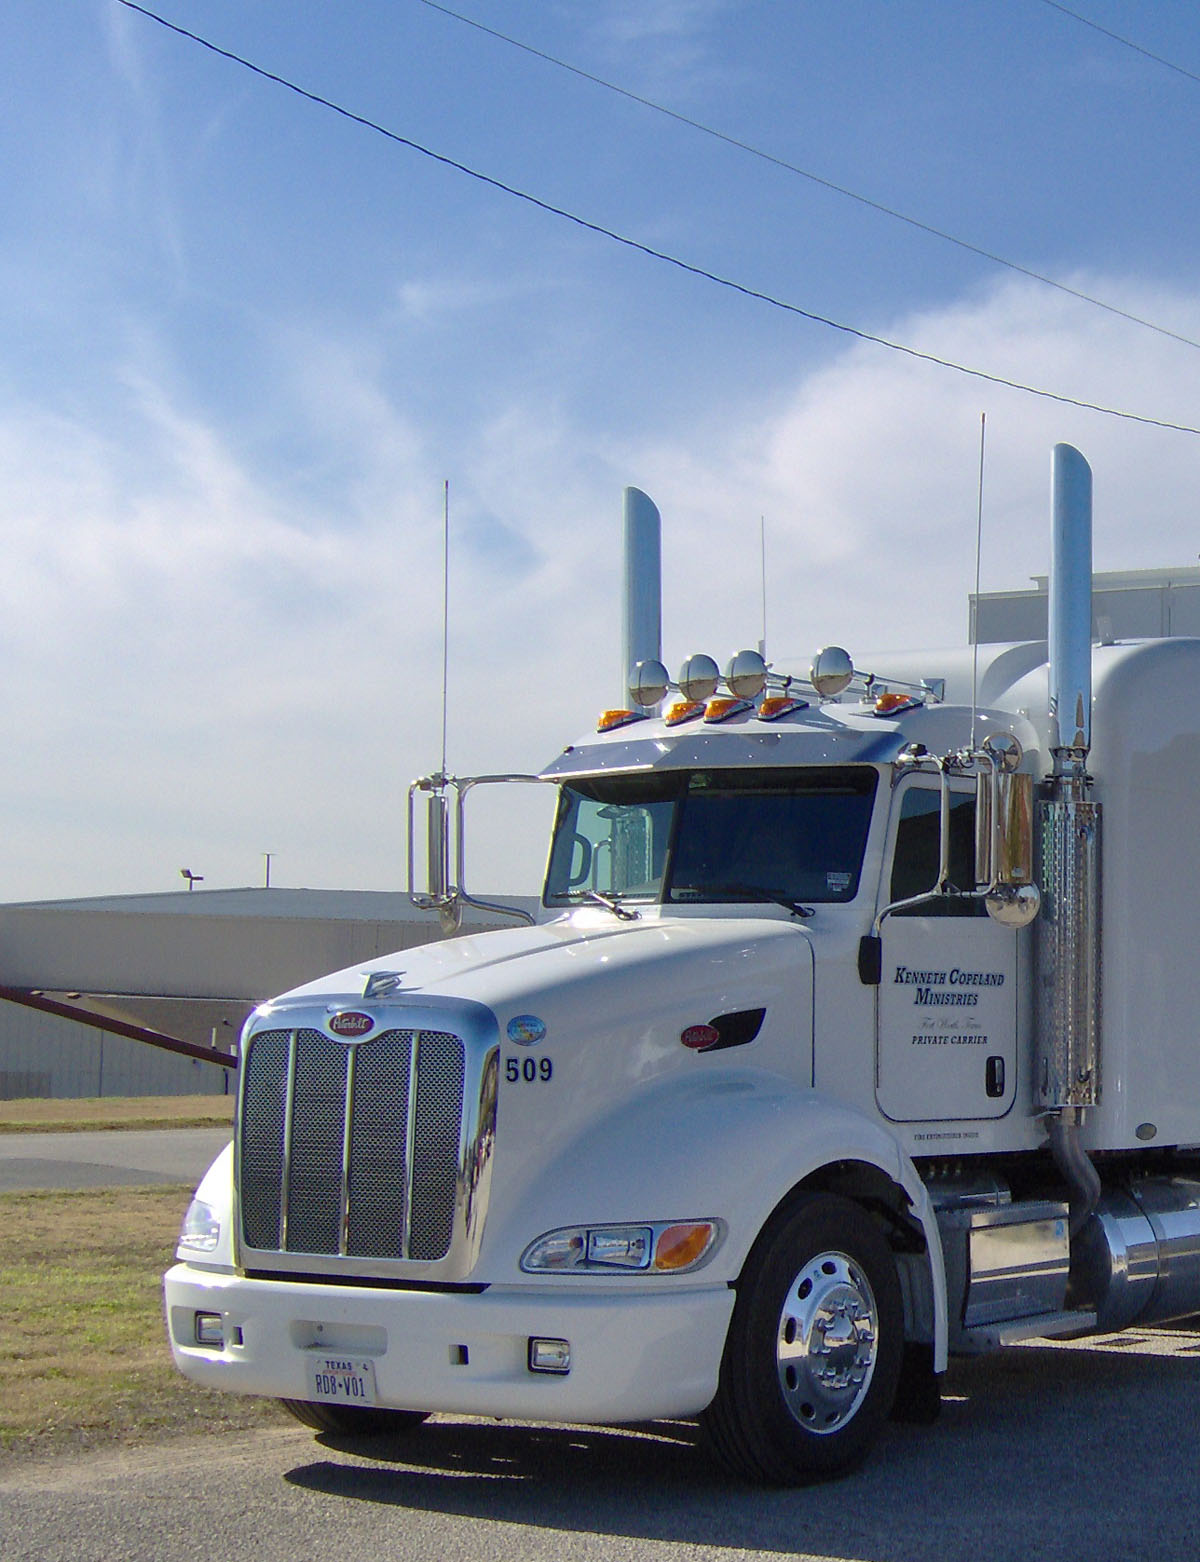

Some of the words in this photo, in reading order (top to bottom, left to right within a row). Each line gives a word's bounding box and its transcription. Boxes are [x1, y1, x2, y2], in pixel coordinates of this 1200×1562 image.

[894, 967, 946, 985] KENNETH
[949, 969, 1004, 986] COPELAND
[914, 987, 978, 1006] MINISTRIES
[912, 1035, 948, 1045] PRIVATE
[950, 1035, 988, 1045] CARRIER
[506, 1058, 552, 1082] 509
[325, 1360, 352, 1370] TEXAS
